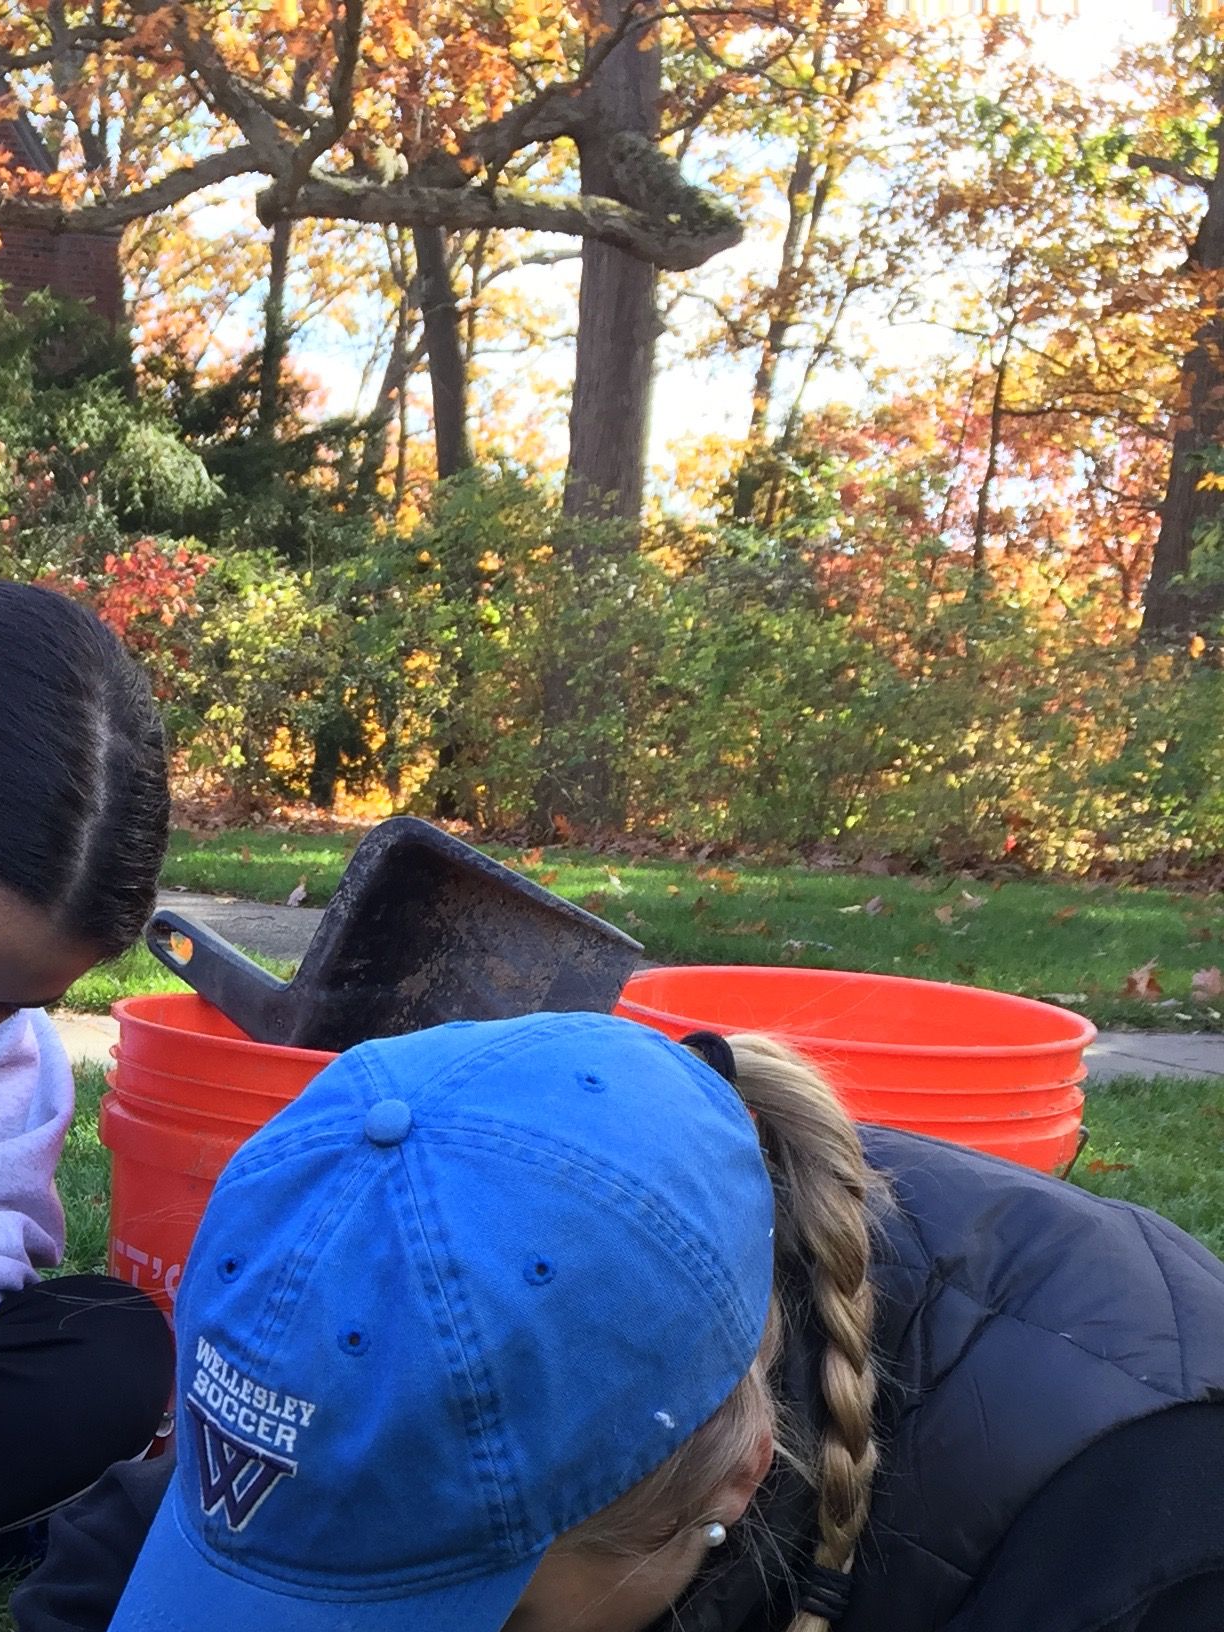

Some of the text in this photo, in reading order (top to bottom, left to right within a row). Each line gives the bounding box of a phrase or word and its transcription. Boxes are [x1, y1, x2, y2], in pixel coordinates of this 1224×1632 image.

[192, 1369, 298, 1453] SOCCER
[196, 1335, 316, 1428] WELLESLEY
[185, 1391, 299, 1533] W
